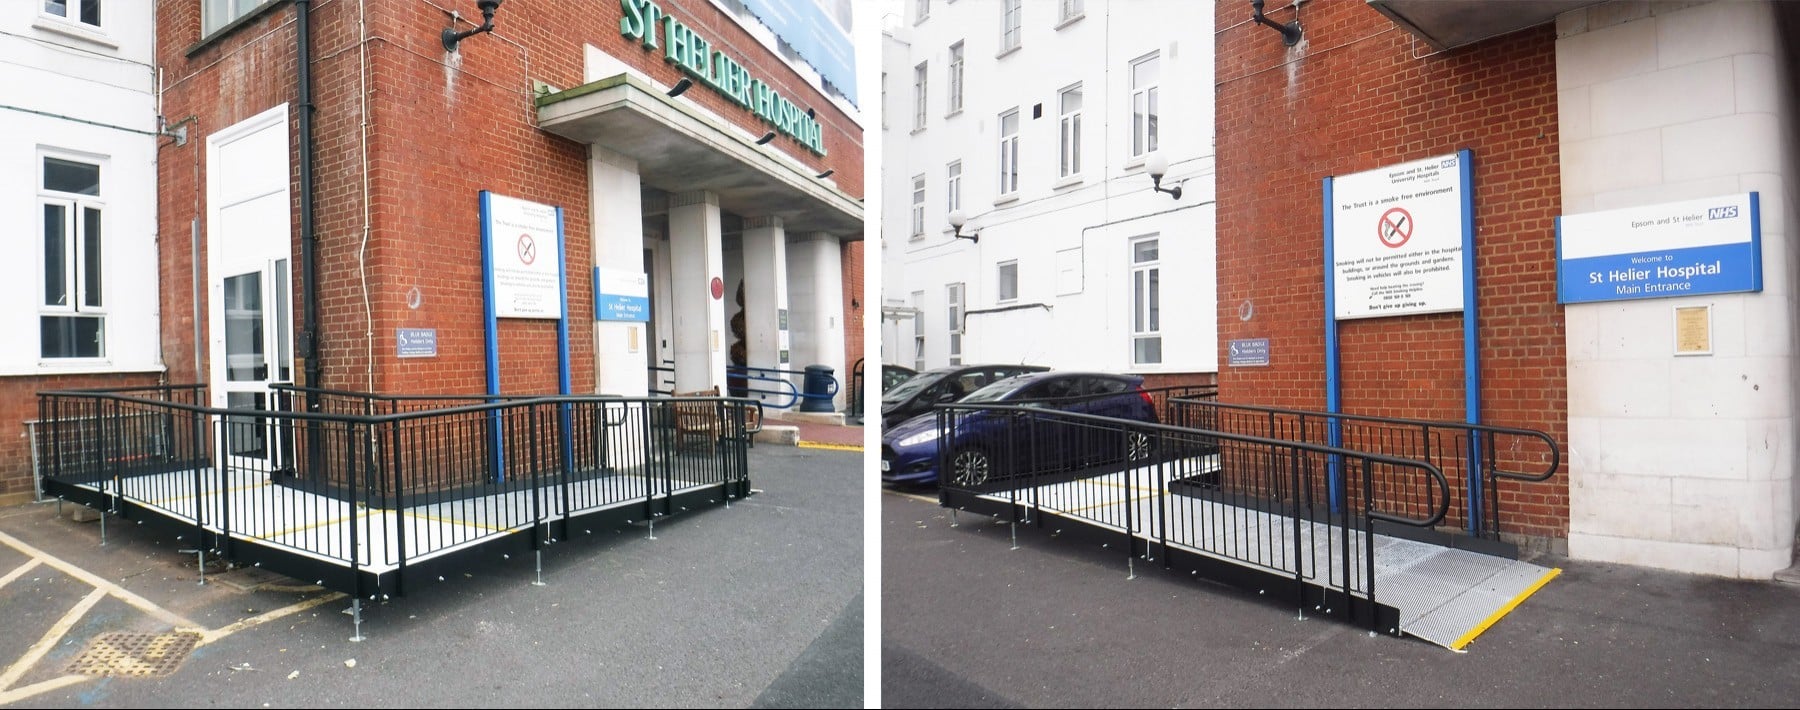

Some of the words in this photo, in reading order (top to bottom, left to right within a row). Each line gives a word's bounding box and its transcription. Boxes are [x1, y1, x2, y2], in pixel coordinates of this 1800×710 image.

[621, 0, 661, 49] ST
[663, 14, 754, 110] HELIER
[751, 78, 827, 157] HOSPITAL
[1441, 159, 1457, 169] NHS
[1391, 175, 1415, 184] University
[1417, 171, 1439, 179] Hospitals
[1380, 196, 1399, 204] smoke
[1415, 186, 1453, 198] environment
[1709, 206, 1738, 220] NHS
[1631, 220, 1654, 229] Epsom
[1657, 217, 1670, 225] and
[1672, 216, 1680, 224] St
[1682, 214, 1703, 222] Helier
[1383, 253, 1407, 262] permitted
[1400, 260, 1420, 268] grounds
[1631, 255, 1662, 264] Welcome
[1589, 271, 1603, 285] St
[1609, 266, 1651, 283] Helier
[1657, 260, 1721, 280] Hospital
[1616, 283, 1641, 295] Main
[1645, 281, 1691, 293] Entrance
